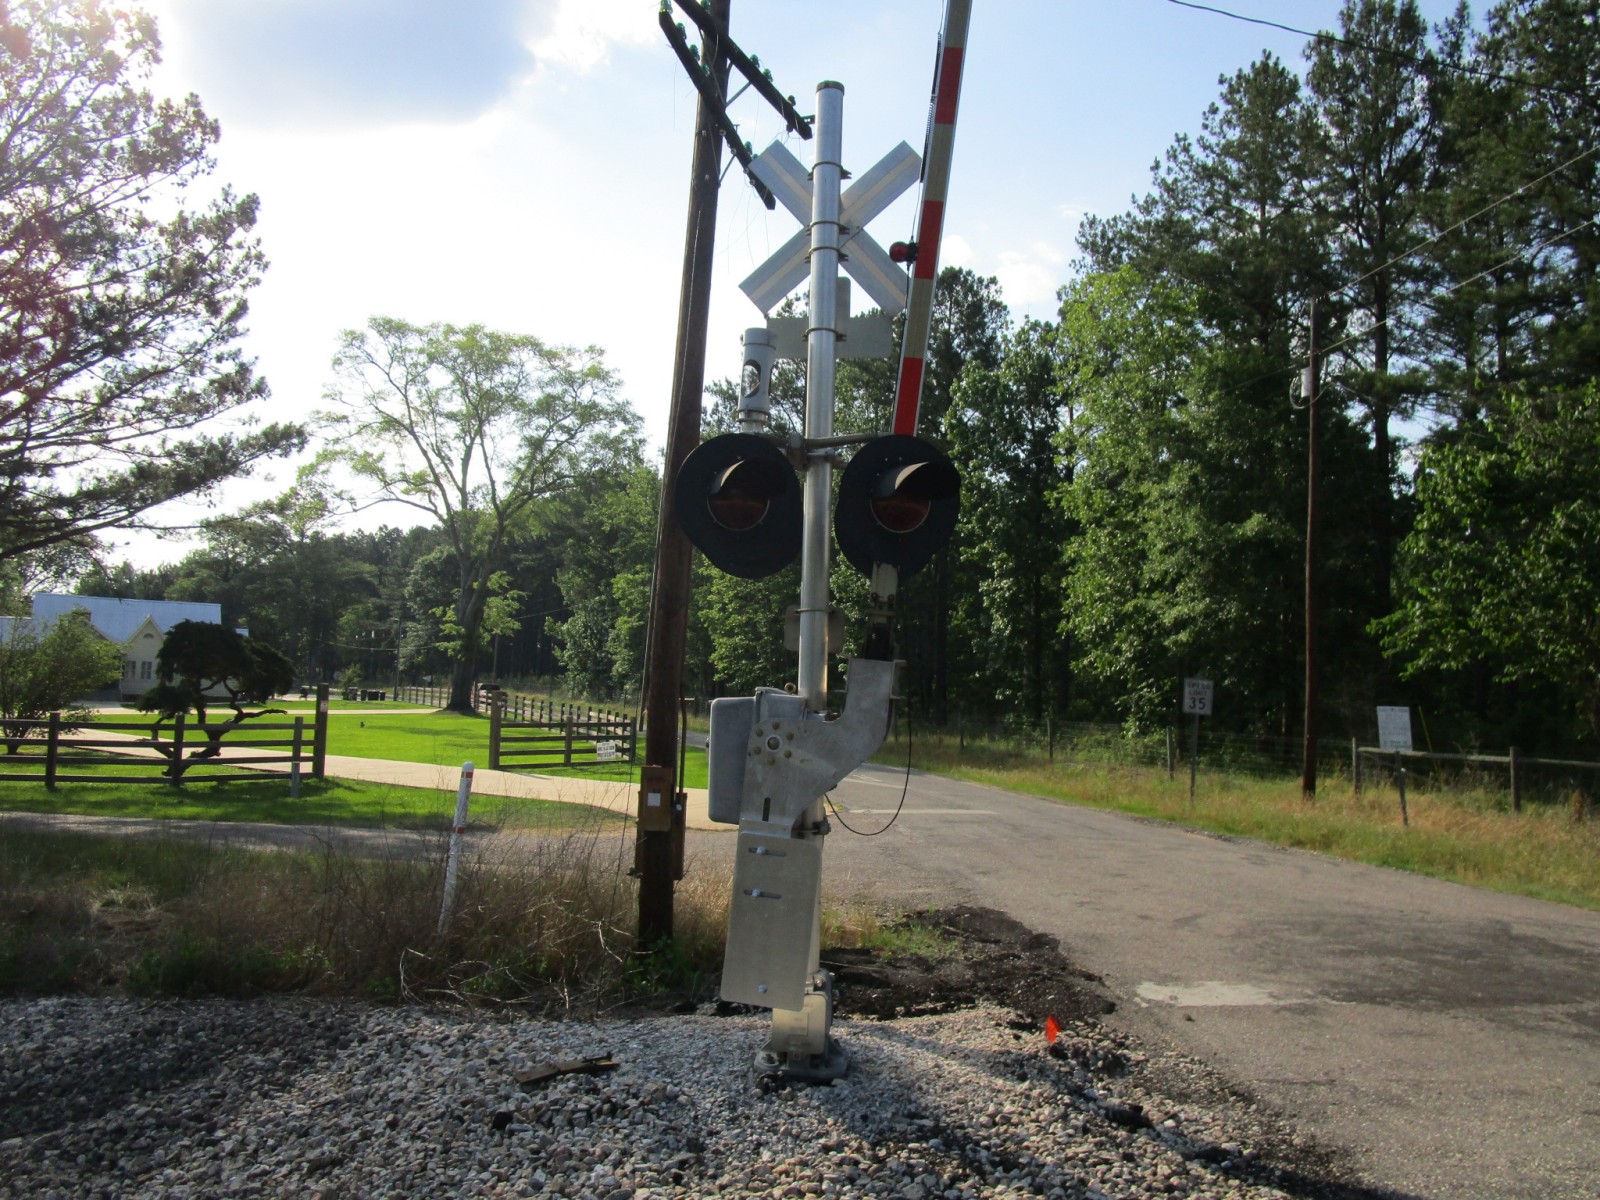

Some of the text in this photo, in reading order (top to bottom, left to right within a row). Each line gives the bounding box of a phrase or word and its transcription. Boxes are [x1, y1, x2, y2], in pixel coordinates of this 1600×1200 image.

[1187, 681, 1211, 690] SPEED
[1188, 689, 1207, 697] LIMIT
[1188, 697, 1206, 710] 35
